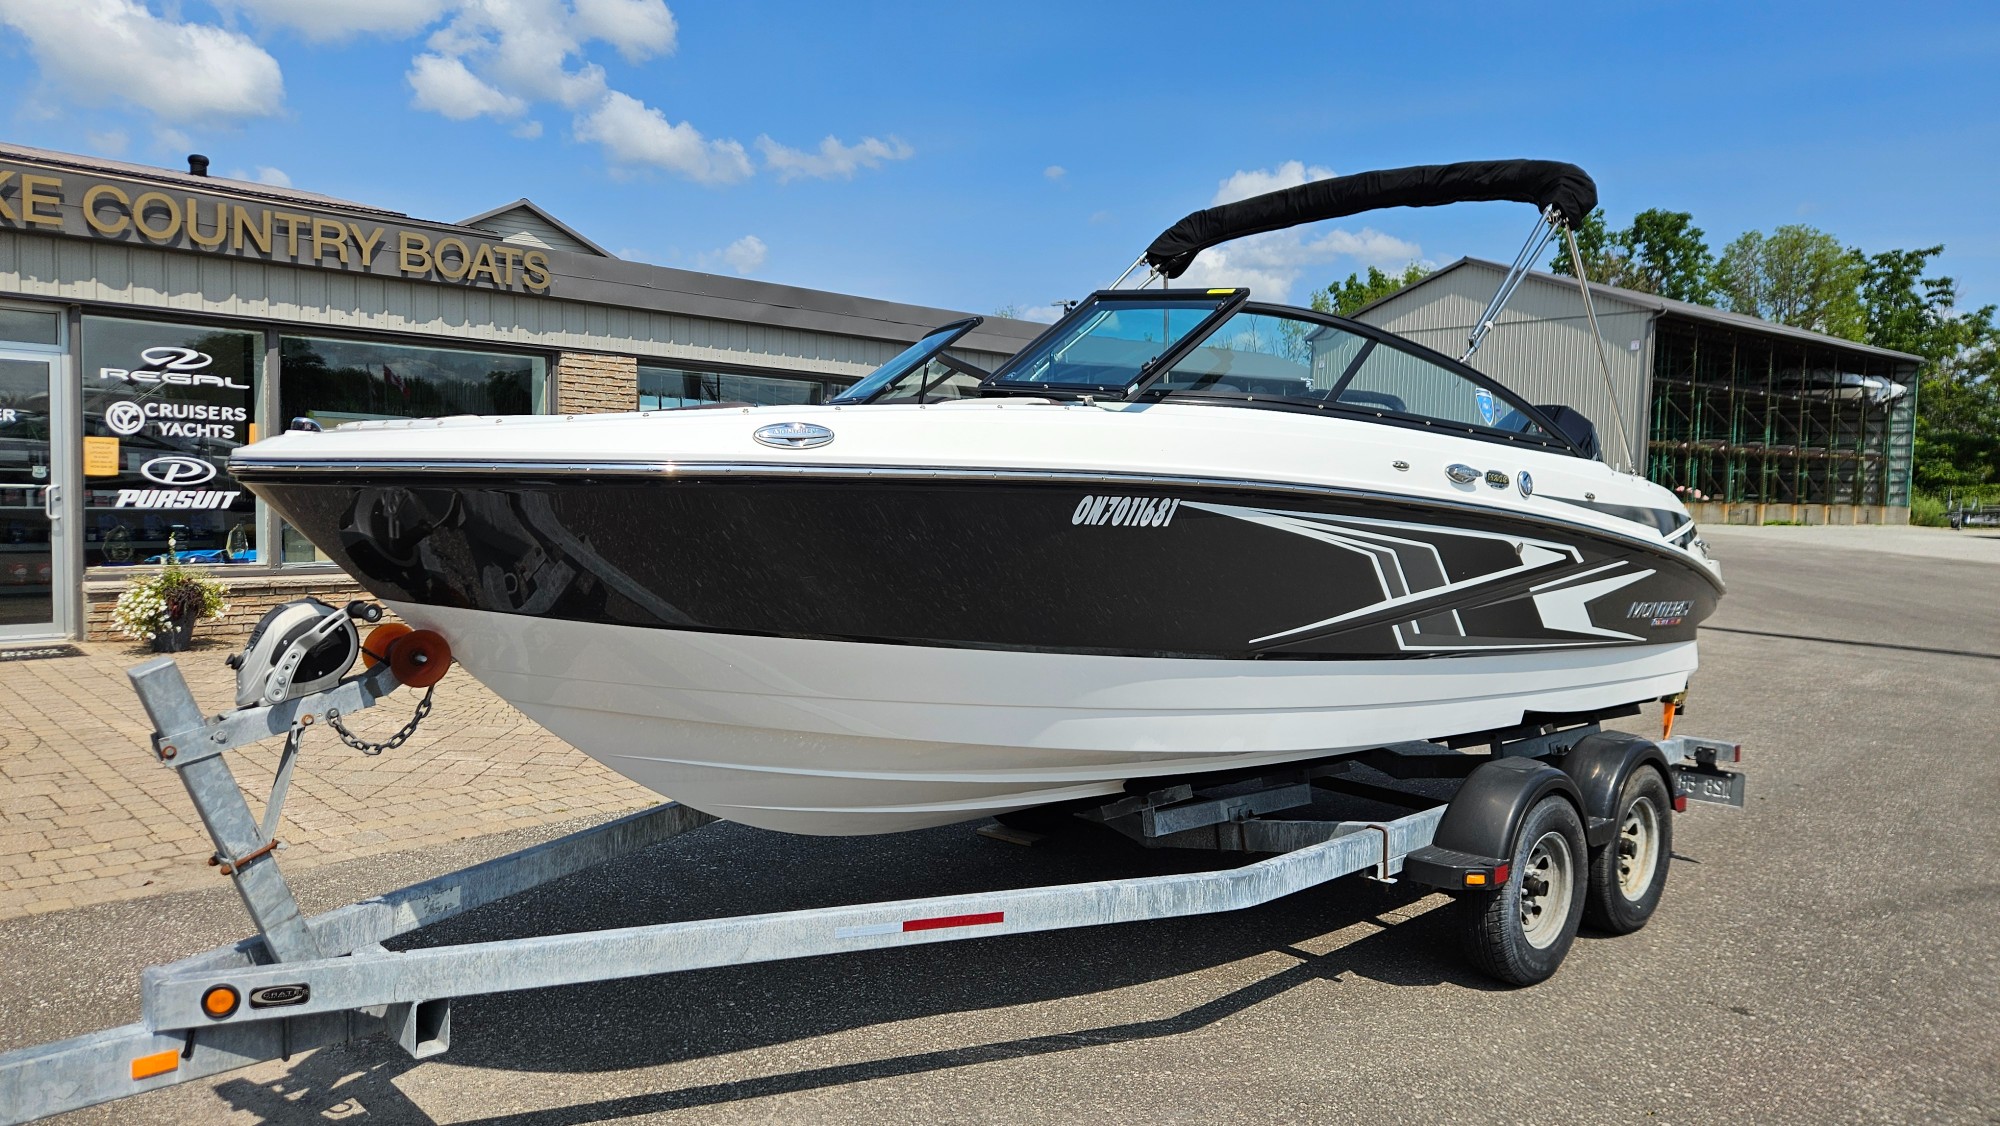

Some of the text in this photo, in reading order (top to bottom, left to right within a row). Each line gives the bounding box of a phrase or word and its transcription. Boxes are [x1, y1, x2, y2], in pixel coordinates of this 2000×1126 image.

[83, 184, 384, 266] COUNTRY
[400, 231, 550, 289] BOATS
[100, 367, 250, 390] REGAL
[144, 402, 247, 421] CRUISERS
[158, 422, 235, 438] YACHTS
[115, 489, 241, 509] PURSUIT
[1072, 495, 1180, 527] ON7011681
